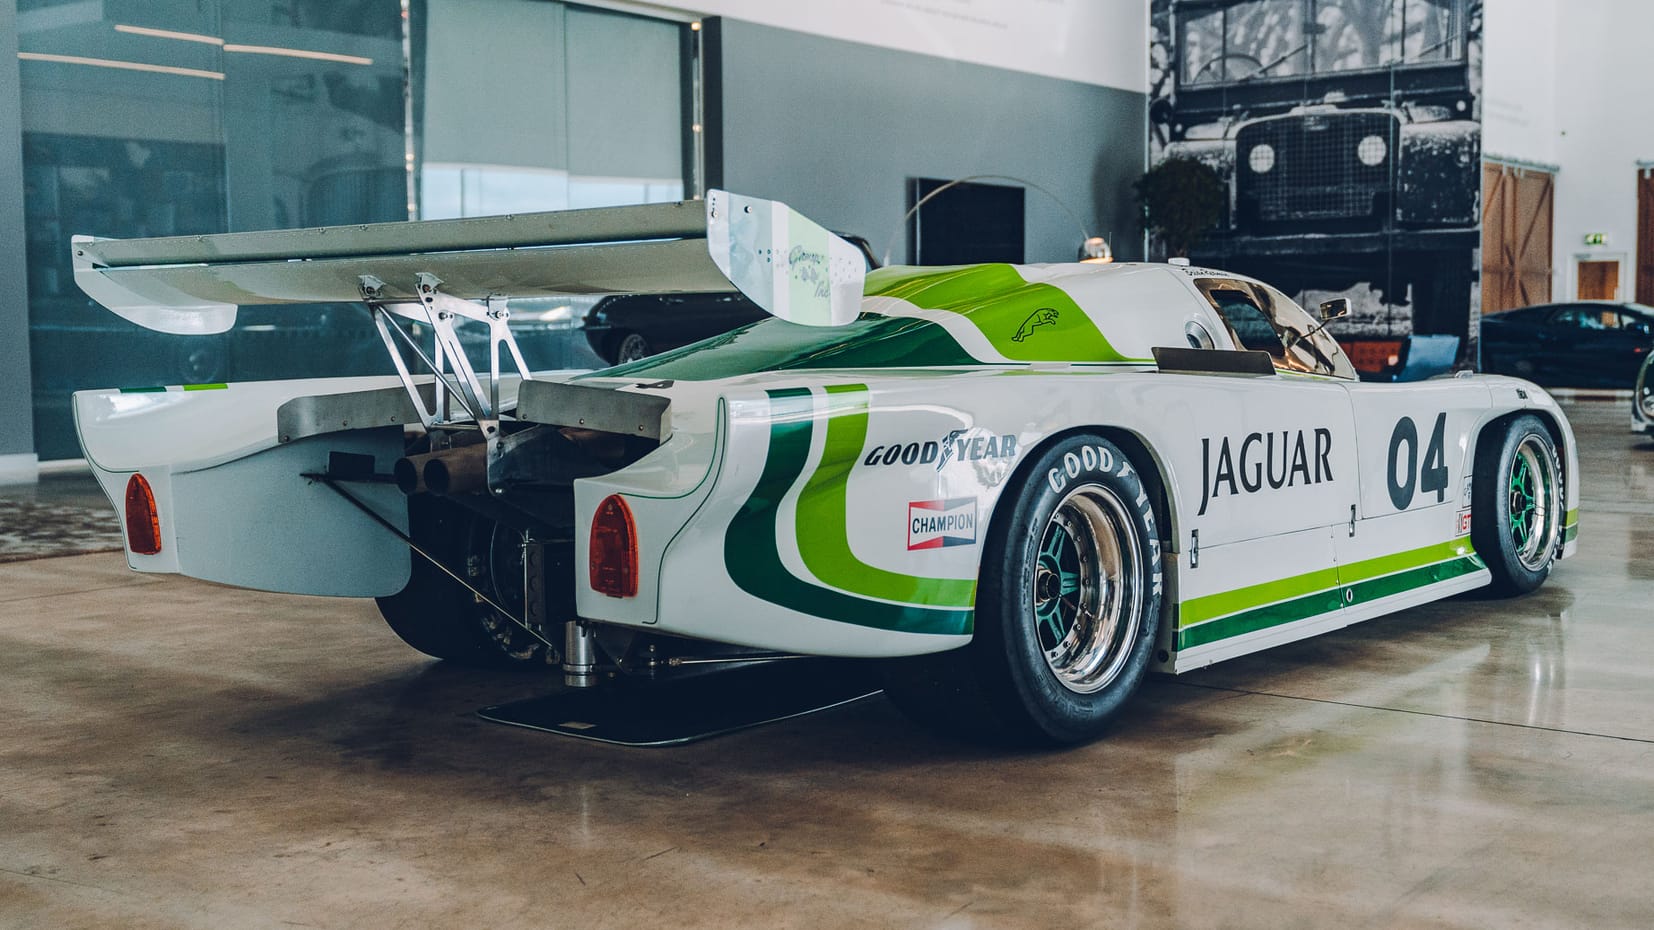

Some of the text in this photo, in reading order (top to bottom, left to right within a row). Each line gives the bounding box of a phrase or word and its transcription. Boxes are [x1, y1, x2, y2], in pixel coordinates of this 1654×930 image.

[1197, 428, 1334, 516] JAGUAR
[1387, 412, 1449, 511] 04
[912, 513, 973, 534] CHAMPION
